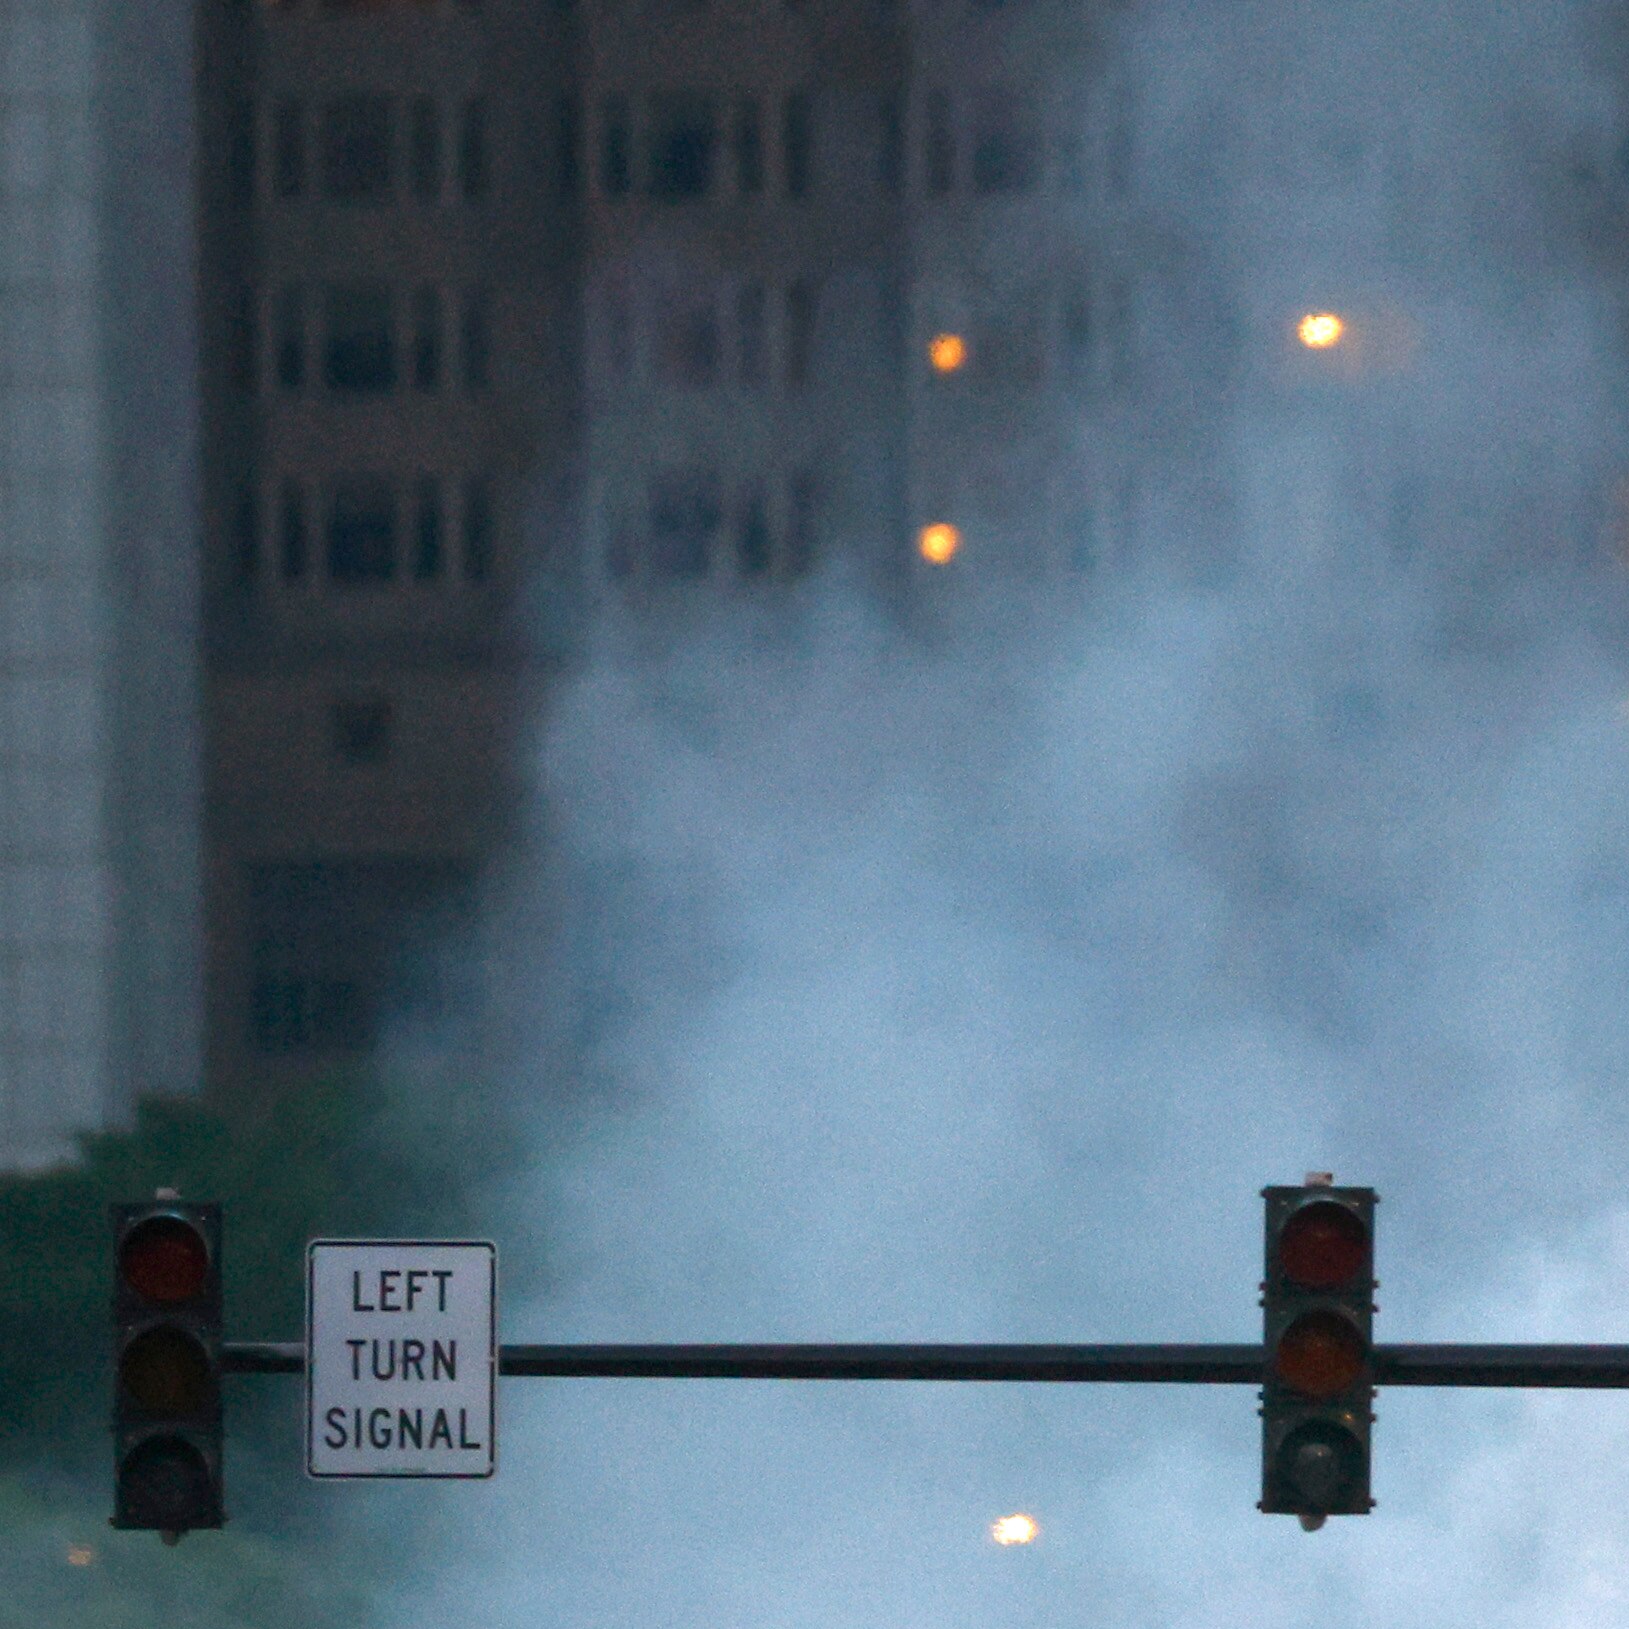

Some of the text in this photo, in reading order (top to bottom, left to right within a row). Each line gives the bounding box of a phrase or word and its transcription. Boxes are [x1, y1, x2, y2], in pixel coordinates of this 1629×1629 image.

[354, 1270, 453, 1312] LEFT
[346, 1339, 457, 1381] TURN
[324, 1407, 481, 1450] SIGNAL
